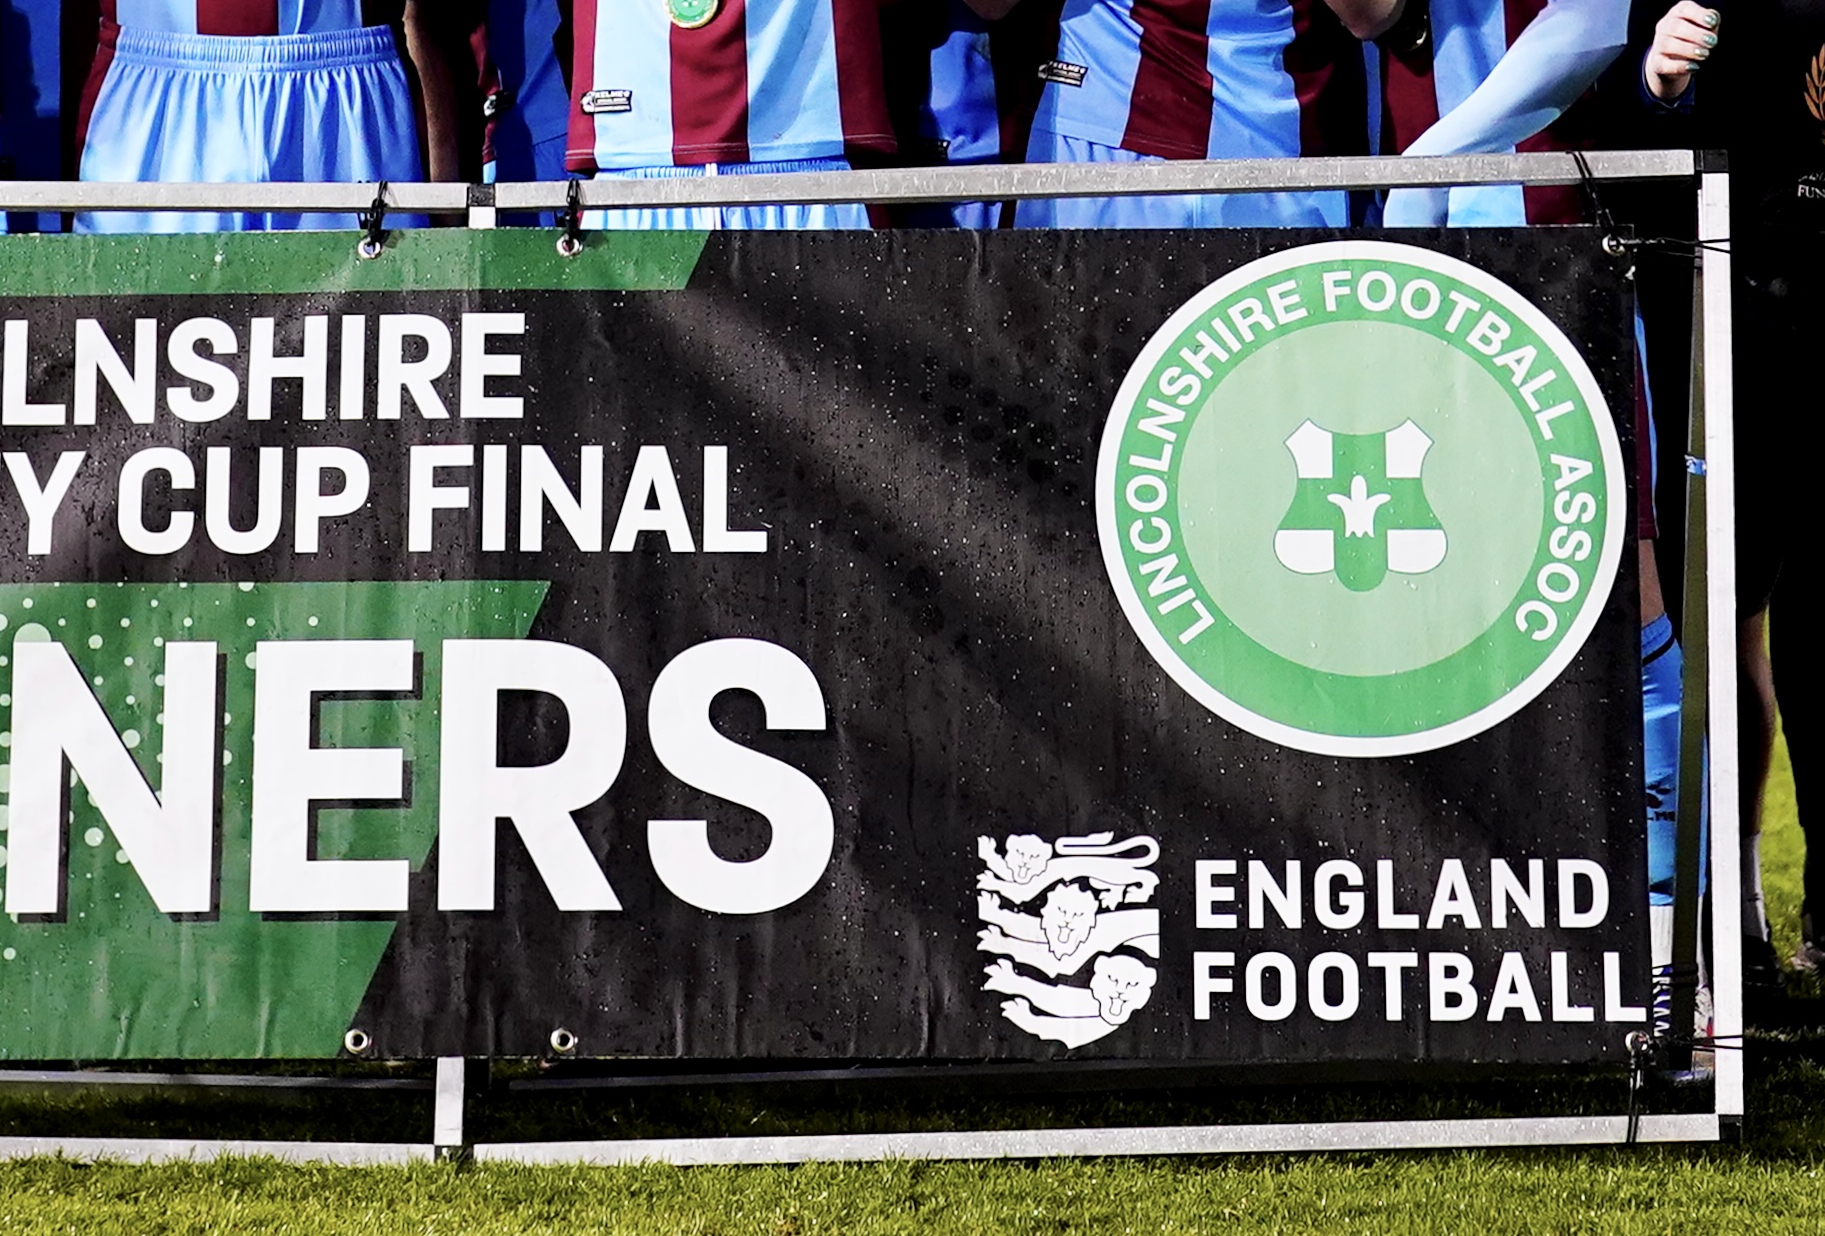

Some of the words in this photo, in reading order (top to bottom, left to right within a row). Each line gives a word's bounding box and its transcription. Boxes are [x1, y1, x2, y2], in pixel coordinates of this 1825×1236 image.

[117, 445, 375, 556] CUP
[406, 444, 769, 555] FINAL
[1125, 278, 1309, 646] LINCOLNSHIRE
[1322, 269, 1577, 442] FOOTBALL
[1514, 451, 1598, 644] ASSOC
[1194, 857, 1611, 931] ENGLAND
[1192, 950, 1648, 1024] FOOTBALL
